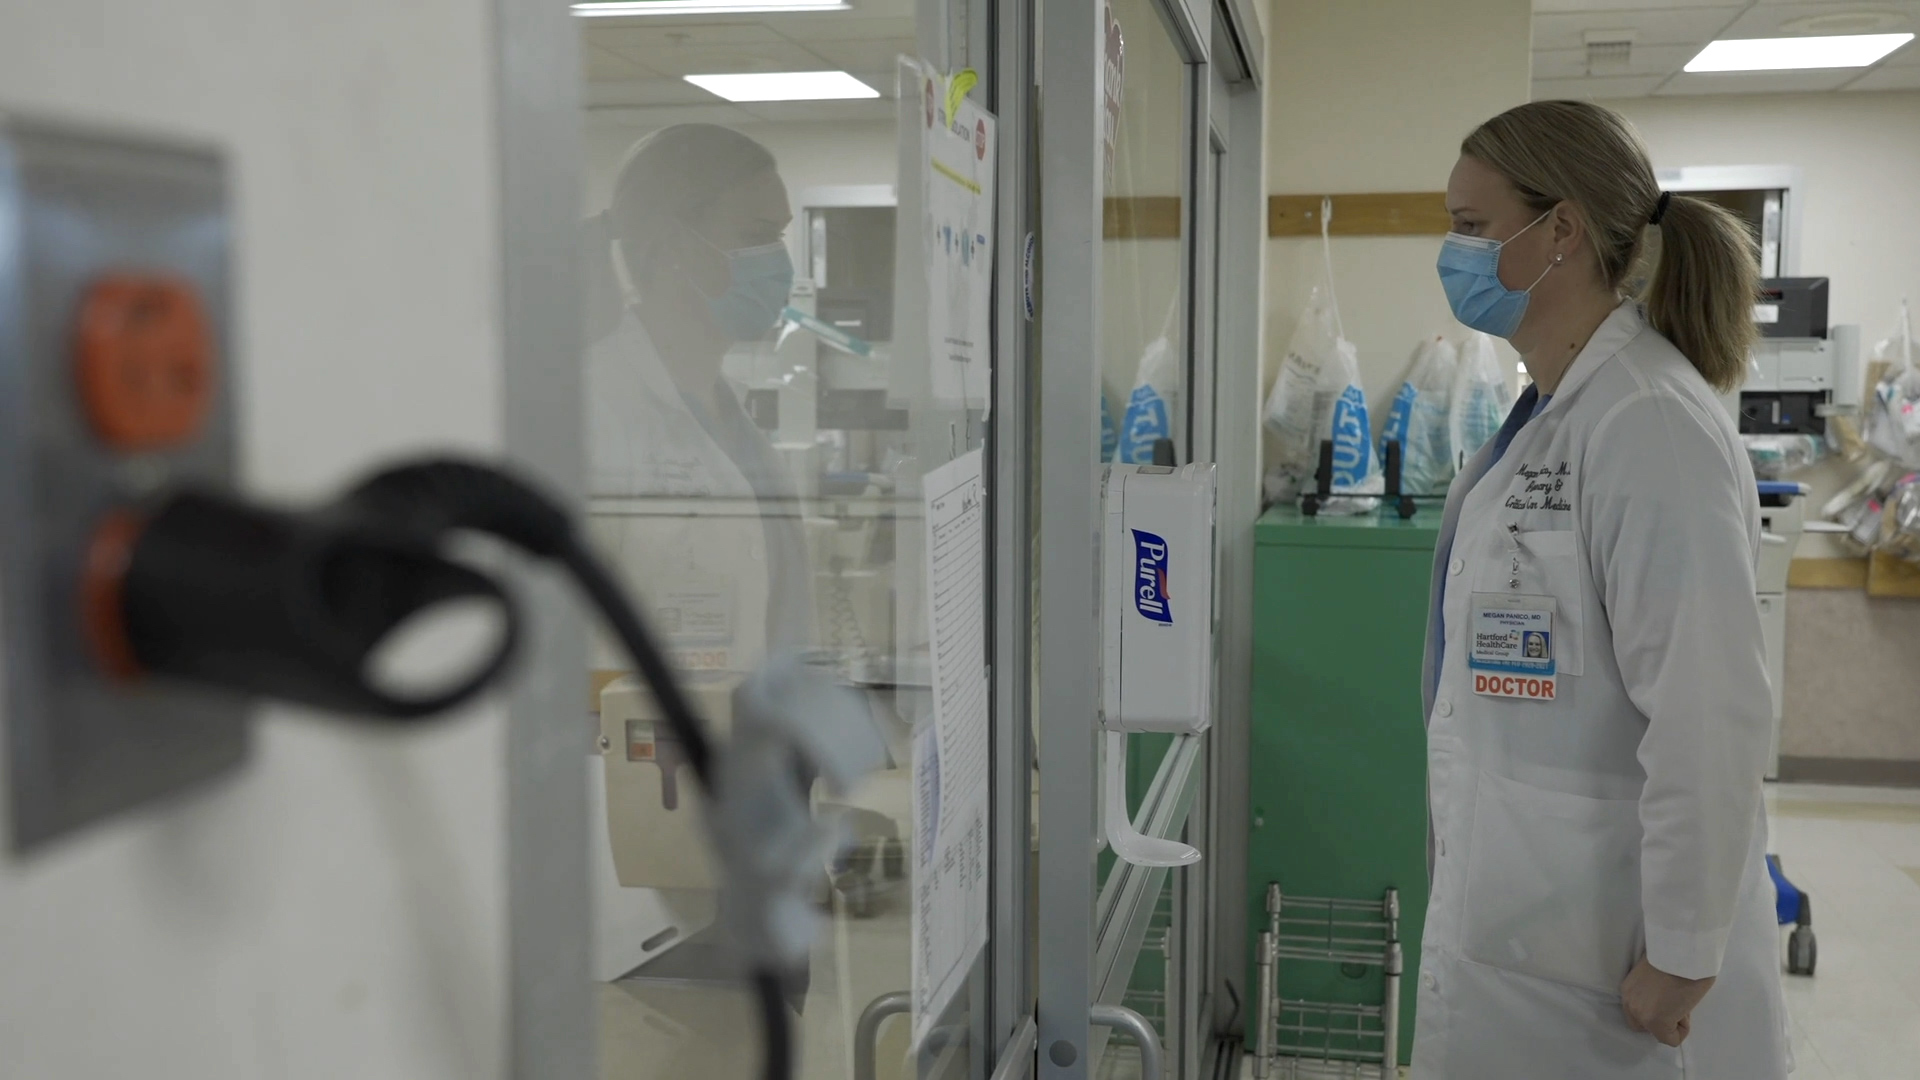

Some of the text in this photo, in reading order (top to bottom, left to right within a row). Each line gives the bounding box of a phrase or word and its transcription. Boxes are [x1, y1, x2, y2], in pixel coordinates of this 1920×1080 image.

[1140, 541, 1165, 615] Purell
[1476, 633, 1508, 641] Hartford
[1476, 640, 1518, 650] HealthCare
[1475, 675, 1555, 698] DOCTOR
